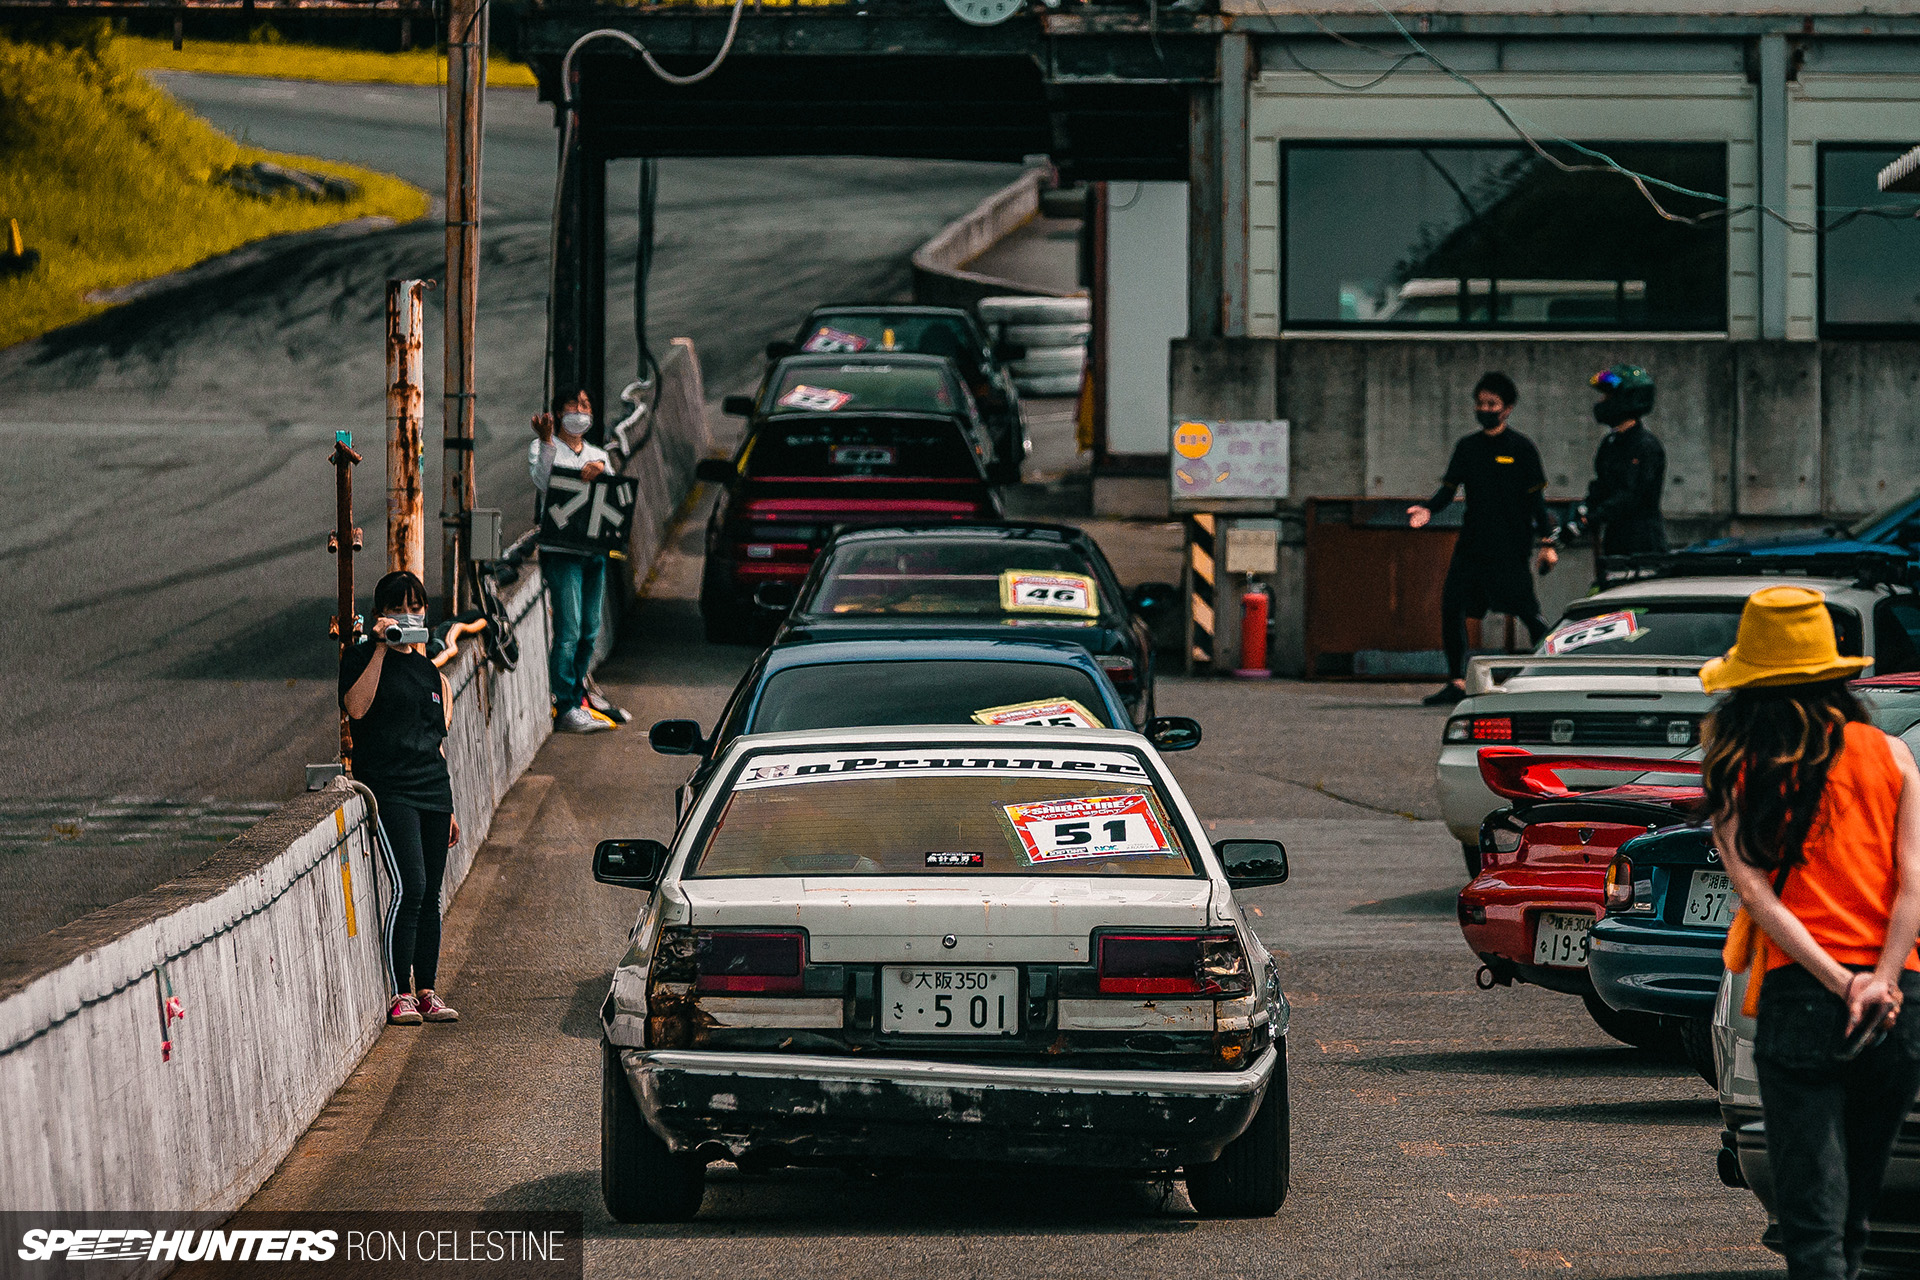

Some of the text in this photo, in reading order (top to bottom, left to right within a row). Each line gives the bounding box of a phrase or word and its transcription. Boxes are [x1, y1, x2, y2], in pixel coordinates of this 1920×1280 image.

[548, 475, 633, 538] マド
[1027, 588, 1075, 600] 46
[1055, 820, 1126, 845] 51
[915, 972, 988, 989] 大阪350
[893, 1002, 904, 1019] さ
